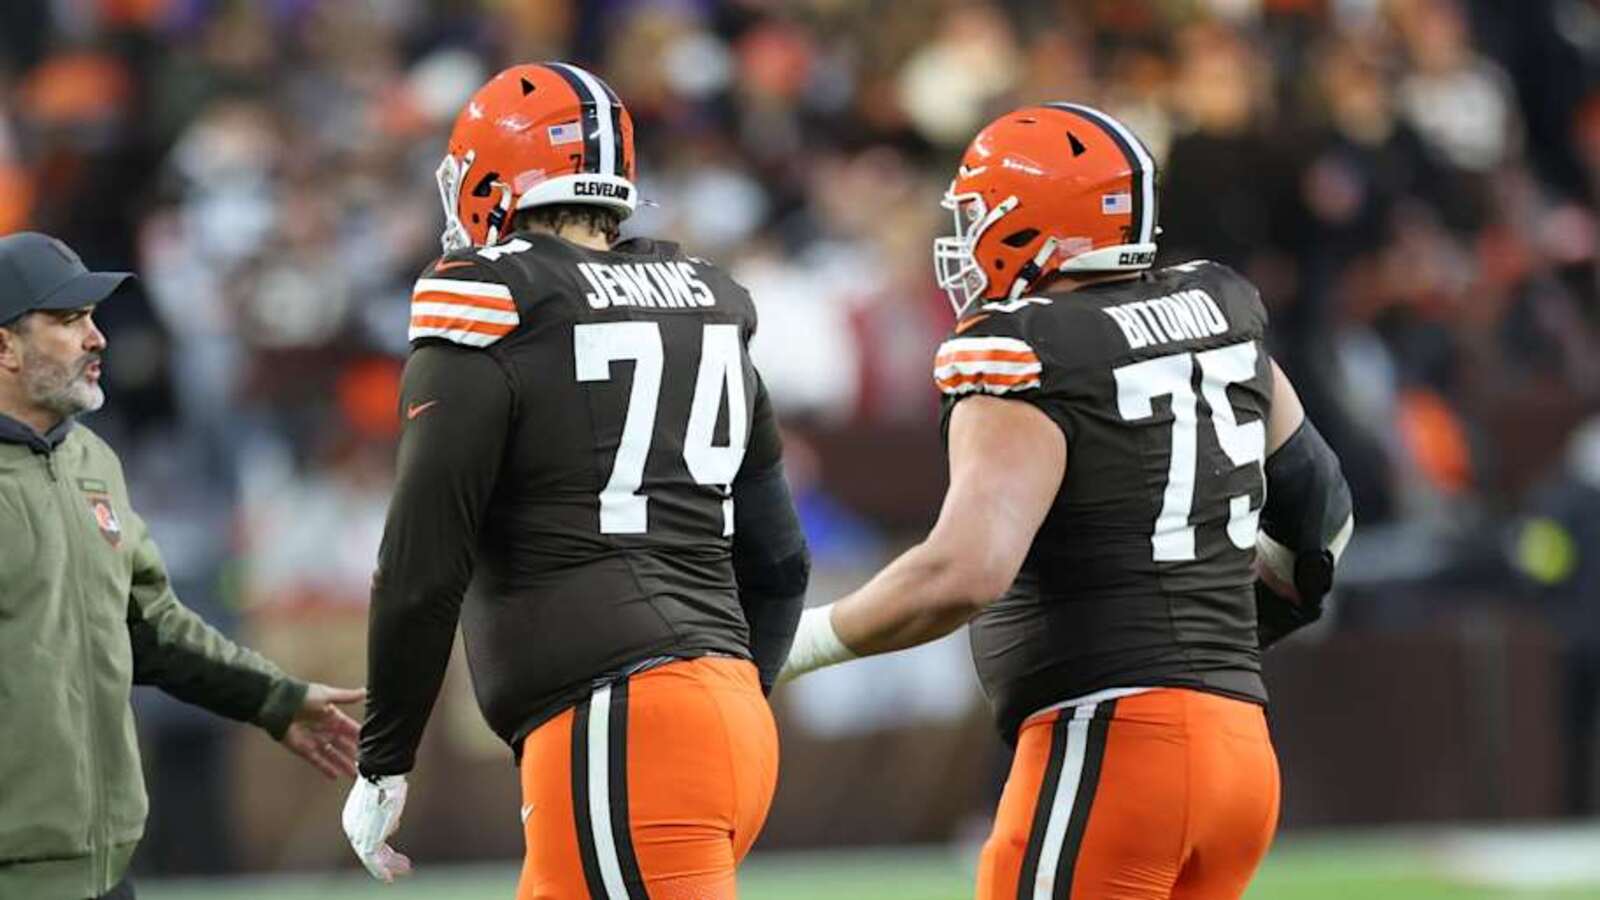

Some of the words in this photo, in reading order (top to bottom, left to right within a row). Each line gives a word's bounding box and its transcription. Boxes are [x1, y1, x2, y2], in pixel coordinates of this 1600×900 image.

[578, 262, 715, 309] JENKINS
[1102, 289, 1229, 349] BITONIO
[574, 321, 748, 536] 74
[1112, 340, 1267, 561] 75
